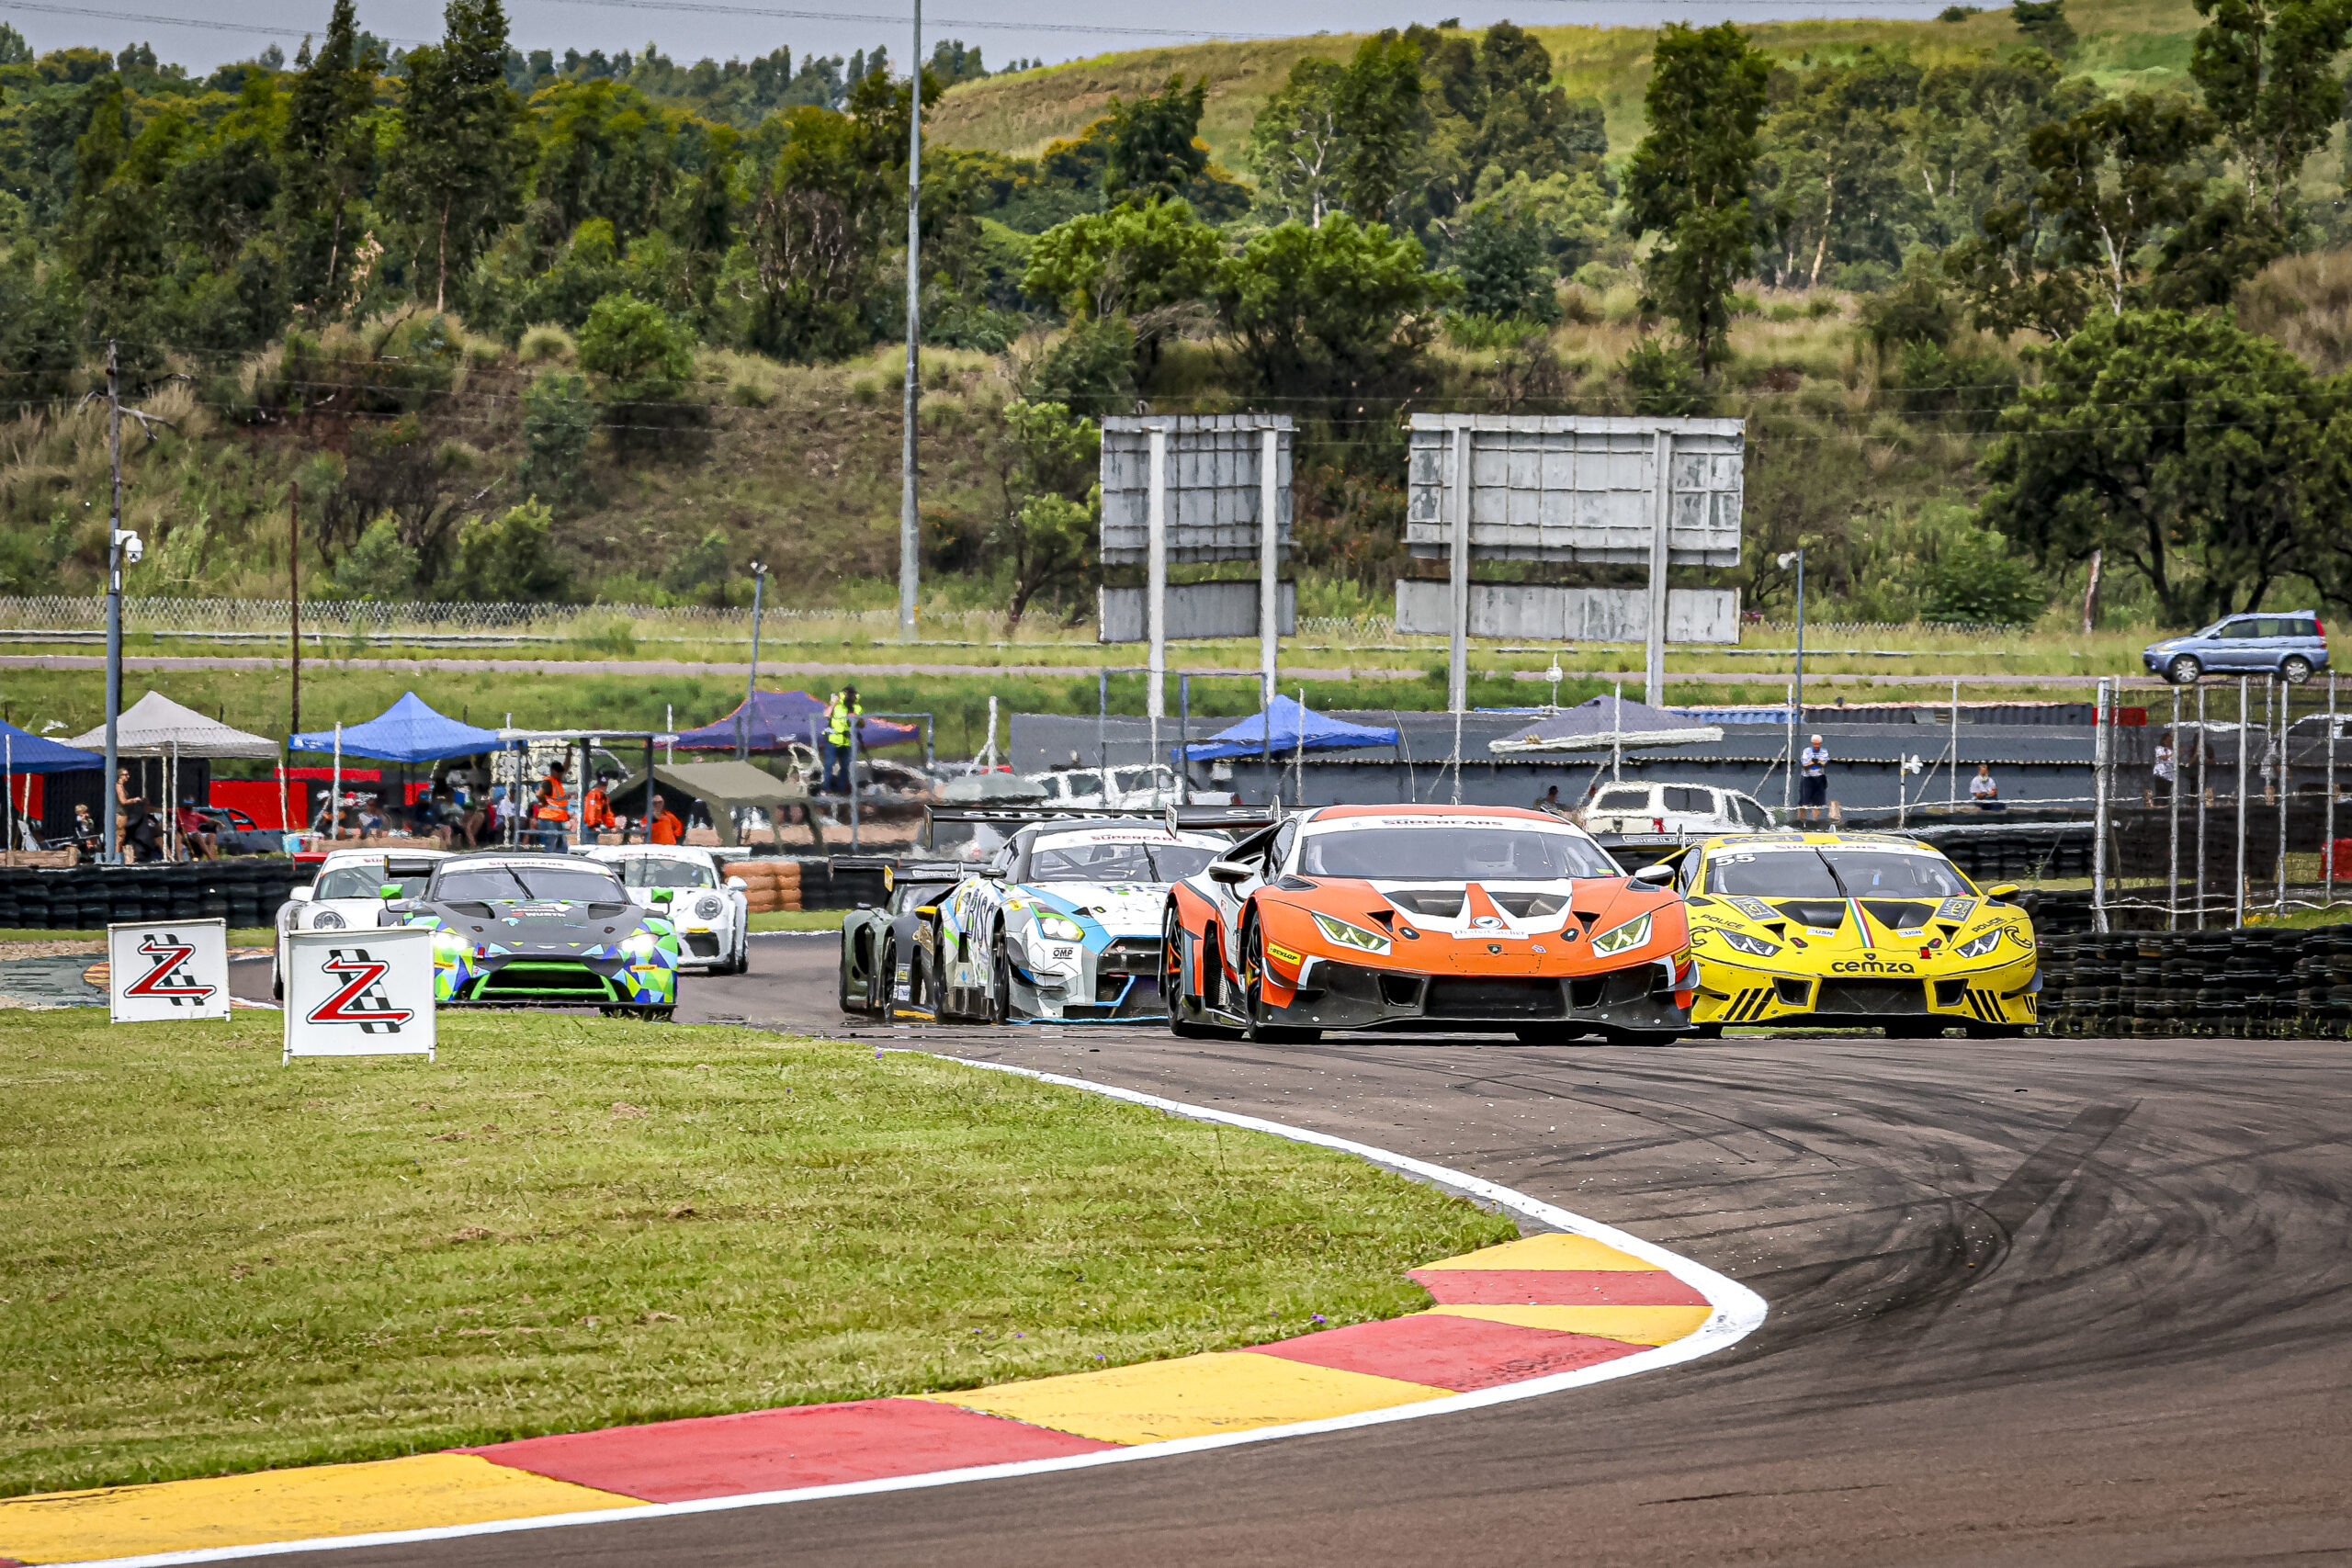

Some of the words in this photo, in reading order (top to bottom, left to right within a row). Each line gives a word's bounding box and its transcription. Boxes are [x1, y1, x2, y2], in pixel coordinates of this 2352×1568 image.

[1714, 852, 1757, 867] 55
[1701, 914, 1746, 930] POLICE
[1971, 917, 2005, 932] POLICE
[1053, 949, 1074, 957] OMP
[1831, 961, 1916, 974] cemza
